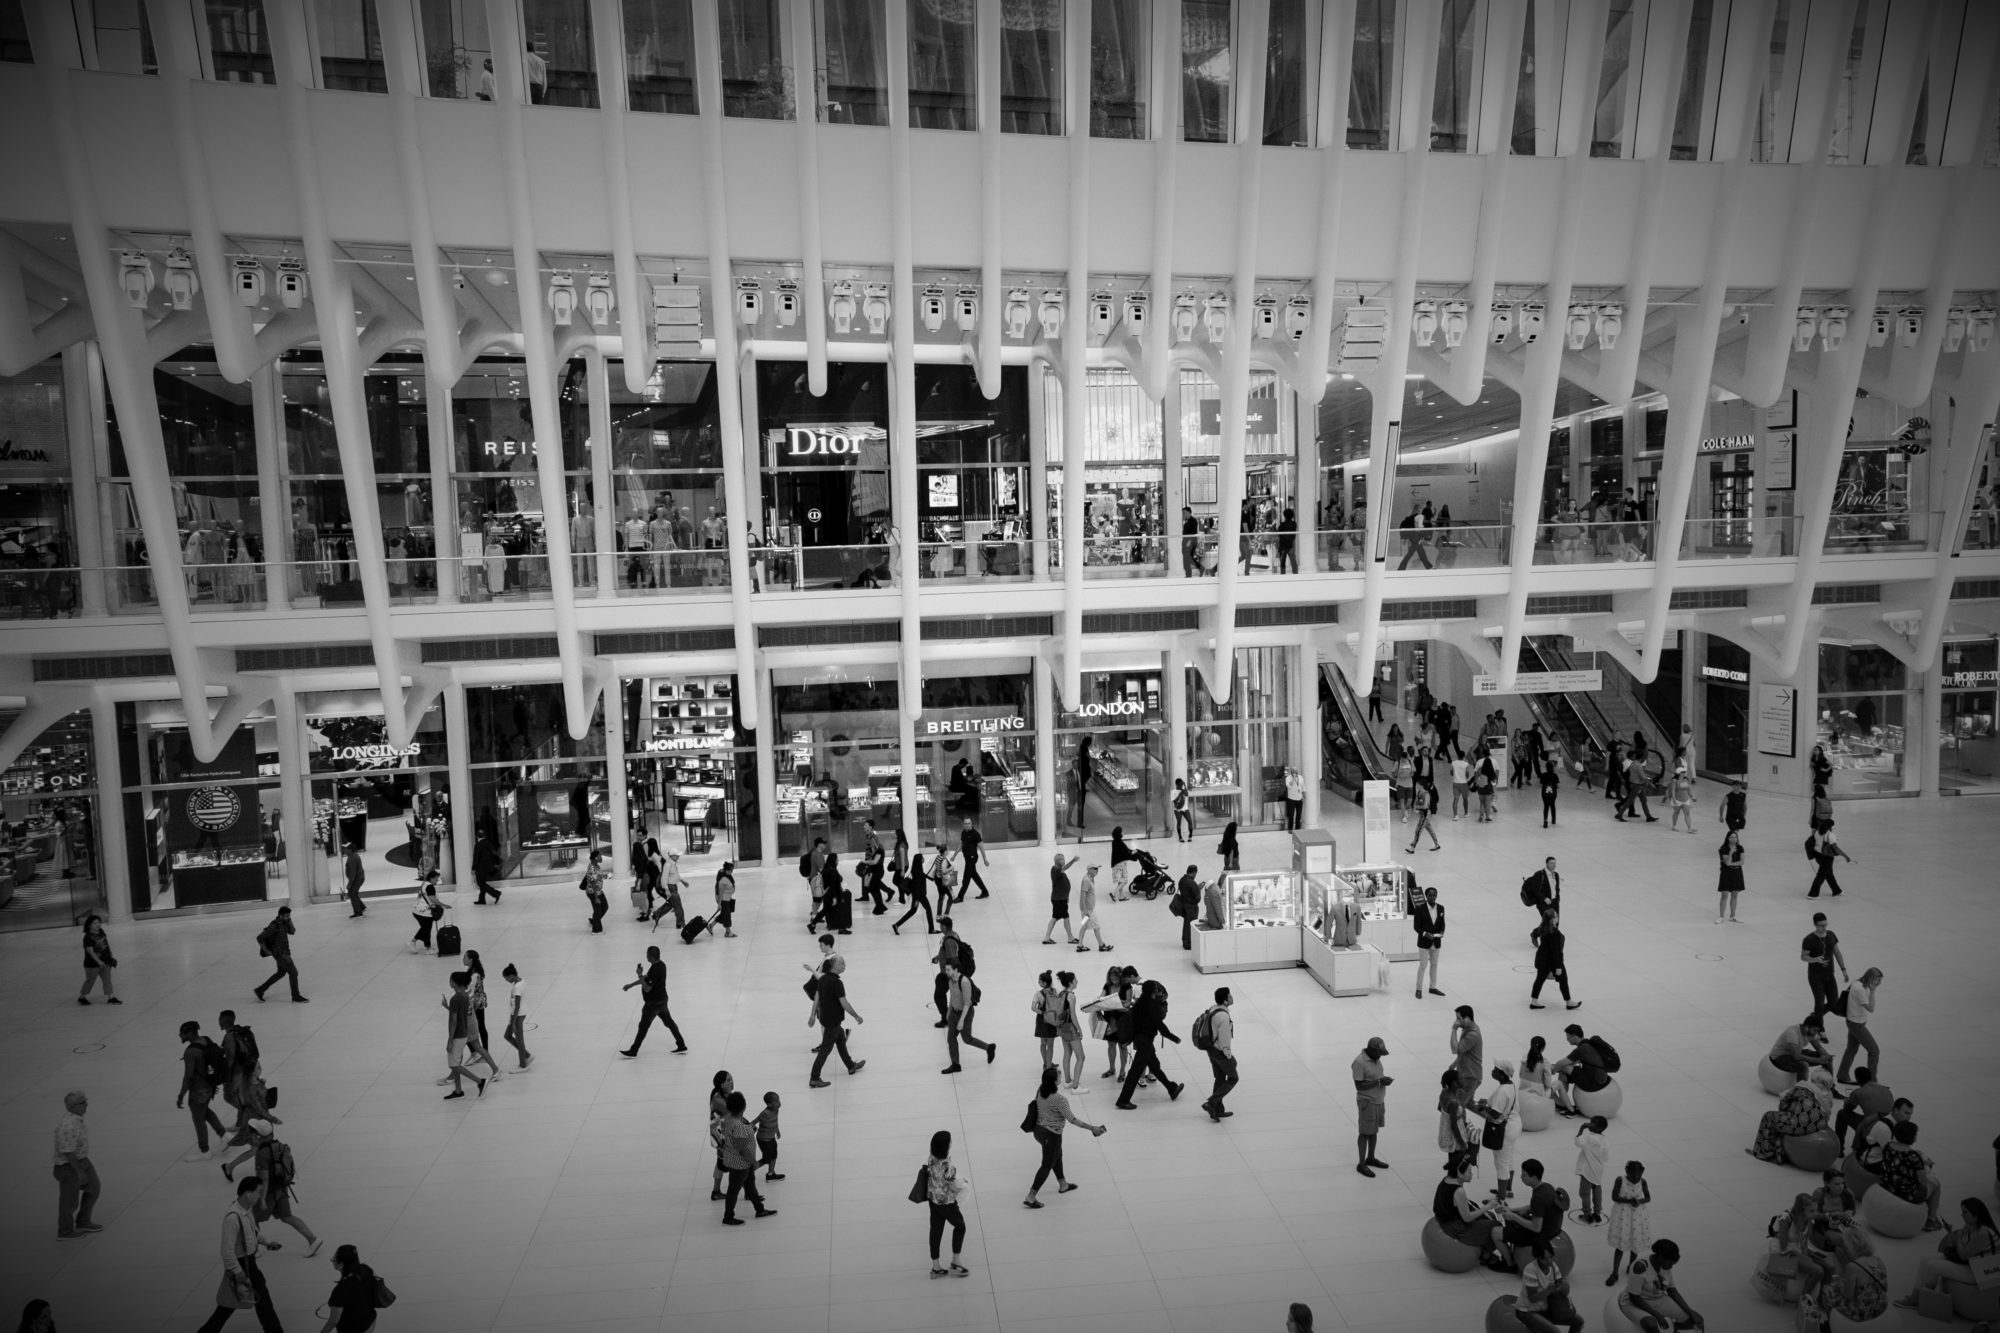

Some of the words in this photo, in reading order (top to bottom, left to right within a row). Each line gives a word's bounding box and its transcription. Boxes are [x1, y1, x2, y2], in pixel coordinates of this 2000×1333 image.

[1246, 412, 1263, 421] ade
[484, 441, 538, 455] REIS
[788, 428, 866, 455] Dior
[1702, 438, 1727, 450] COLE
[1729, 435, 1754, 448] HAAN
[1833, 480, 1888, 511] Pinch
[1079, 701, 1145, 717] LONDON
[927, 717, 1025, 734] BREITLING
[645, 736, 725, 751] MONTBLANC
